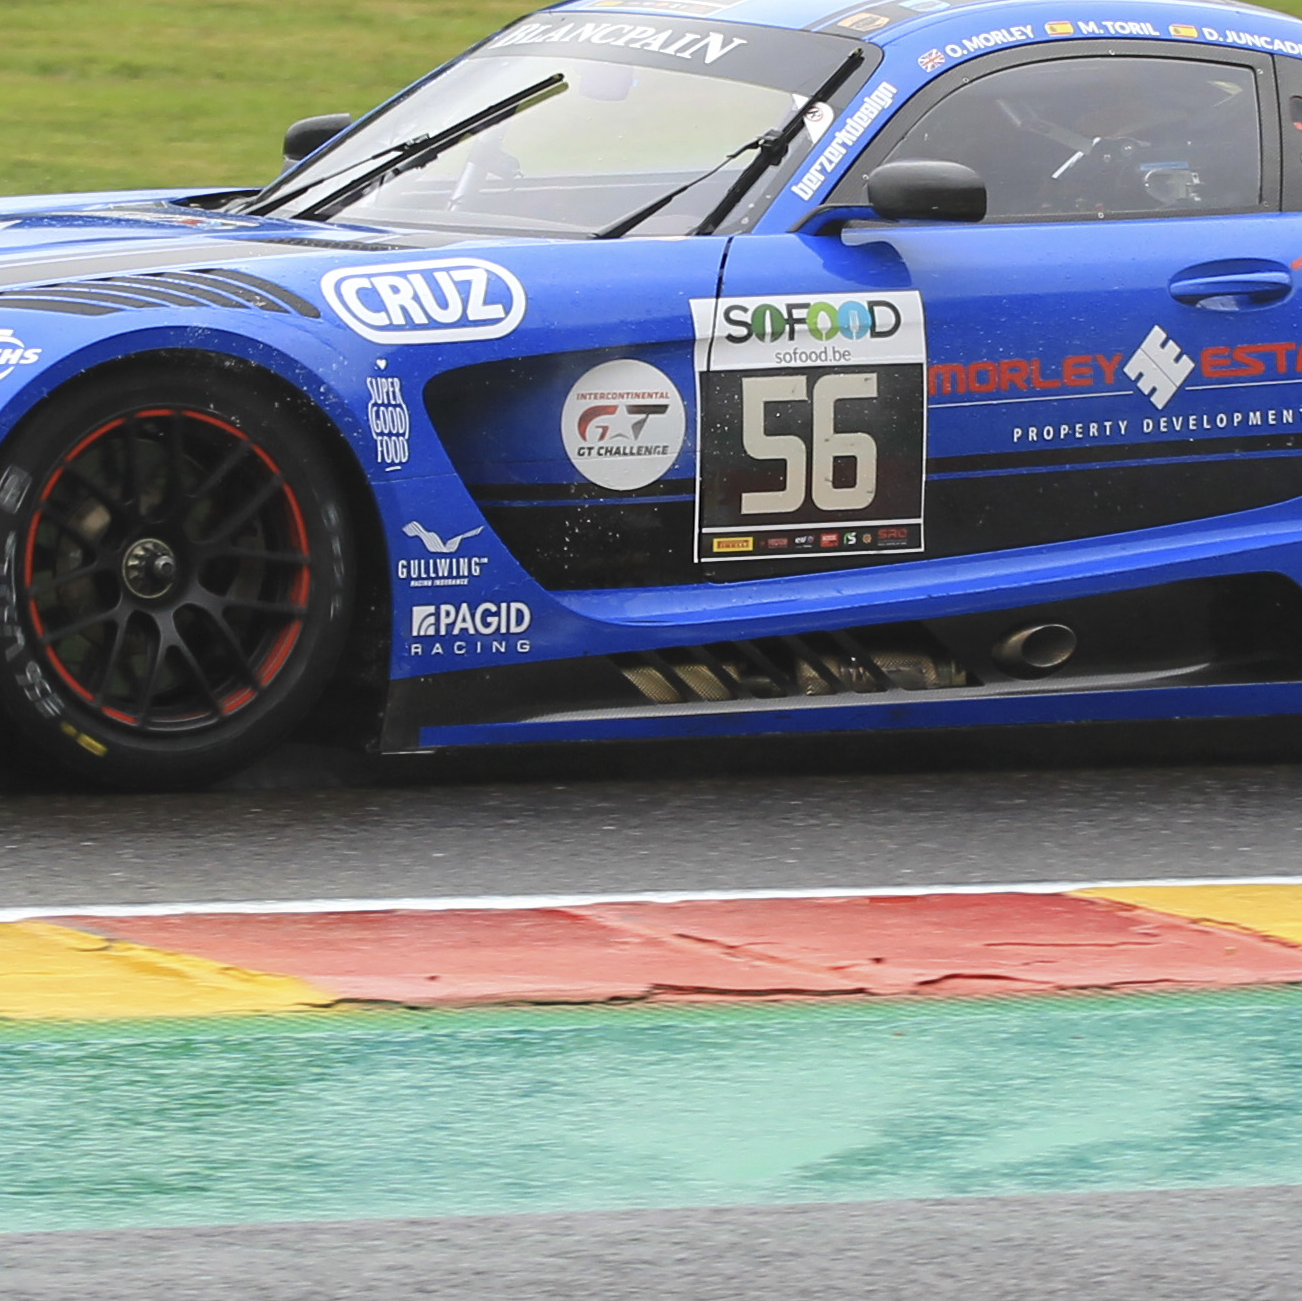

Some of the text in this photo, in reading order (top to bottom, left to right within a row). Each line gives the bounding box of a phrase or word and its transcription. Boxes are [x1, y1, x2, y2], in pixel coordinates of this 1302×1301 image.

[964, 25, 1035, 51] MORLEY
[1101, 20, 1160, 37] TORIL
[488, 22, 748, 64] BLANCPAIN
[790, 81, 898, 201] berzerkdesign
[340, 268, 506, 326] CRUZ
[724, 300, 901, 344] SOFOOD
[775, 346, 852, 364] sofood.be
[928, 353, 1123, 396] MORLEY
[366, 377, 402, 404] SUPER
[576, 391, 670, 401] INTERCONTINENTAL
[372, 406, 405, 433] GOOD
[1012, 419, 1128, 443] PROPERTY
[377, 436, 408, 463] FOOD
[577, 445, 670, 457] GT CHALLENGE
[740, 372, 878, 514] 56
[398, 557, 481, 579] GULLWING
[439, 601, 531, 636] PAGID
[410, 639, 531, 656] RACING
